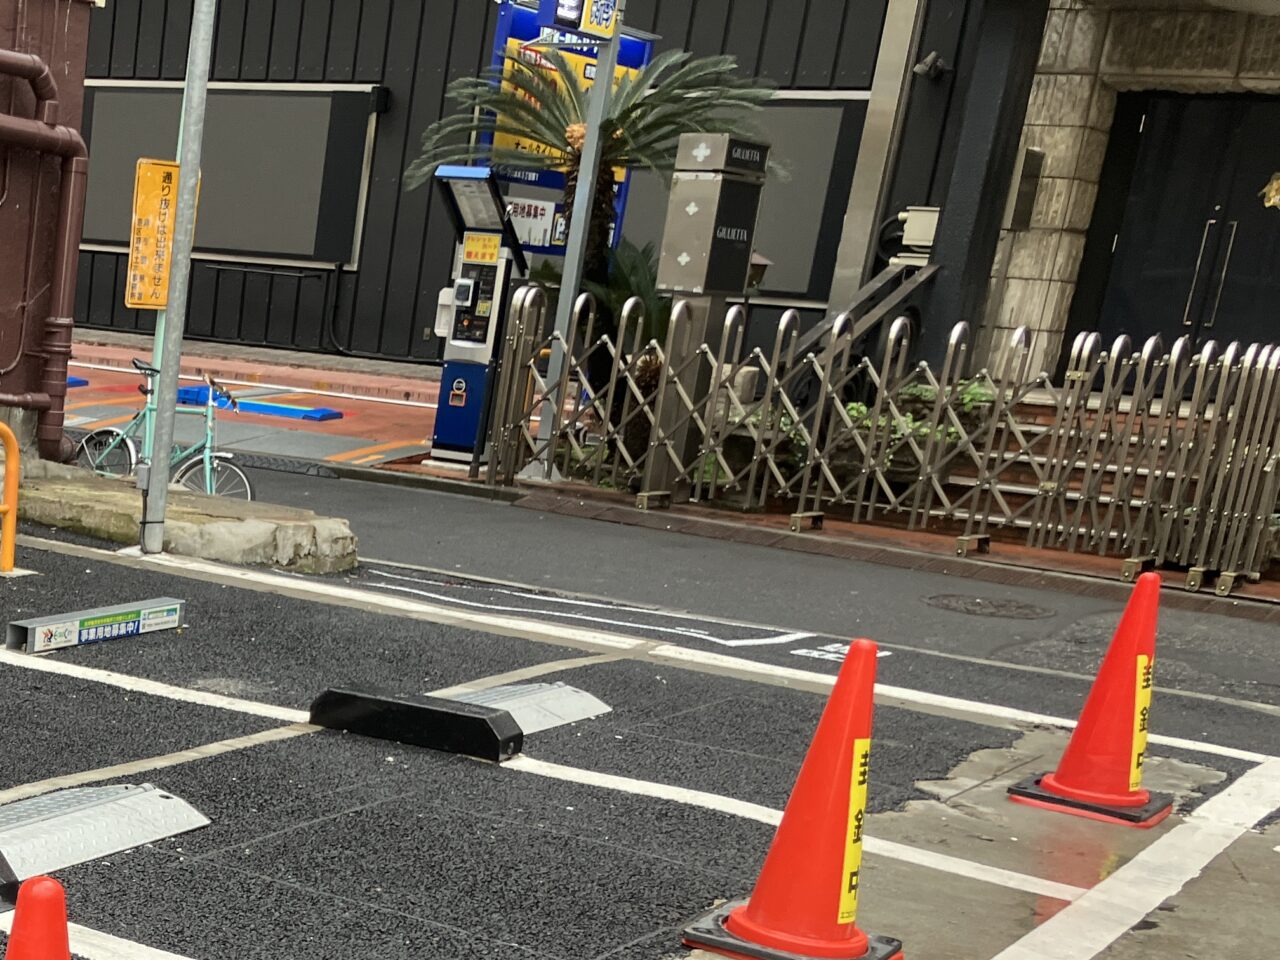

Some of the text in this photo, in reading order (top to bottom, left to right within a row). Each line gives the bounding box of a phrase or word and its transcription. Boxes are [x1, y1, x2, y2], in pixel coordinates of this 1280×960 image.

[150, 171, 173, 299] 通り抜けは出来ません
[506, 201, 546, 219] 用地募集中
